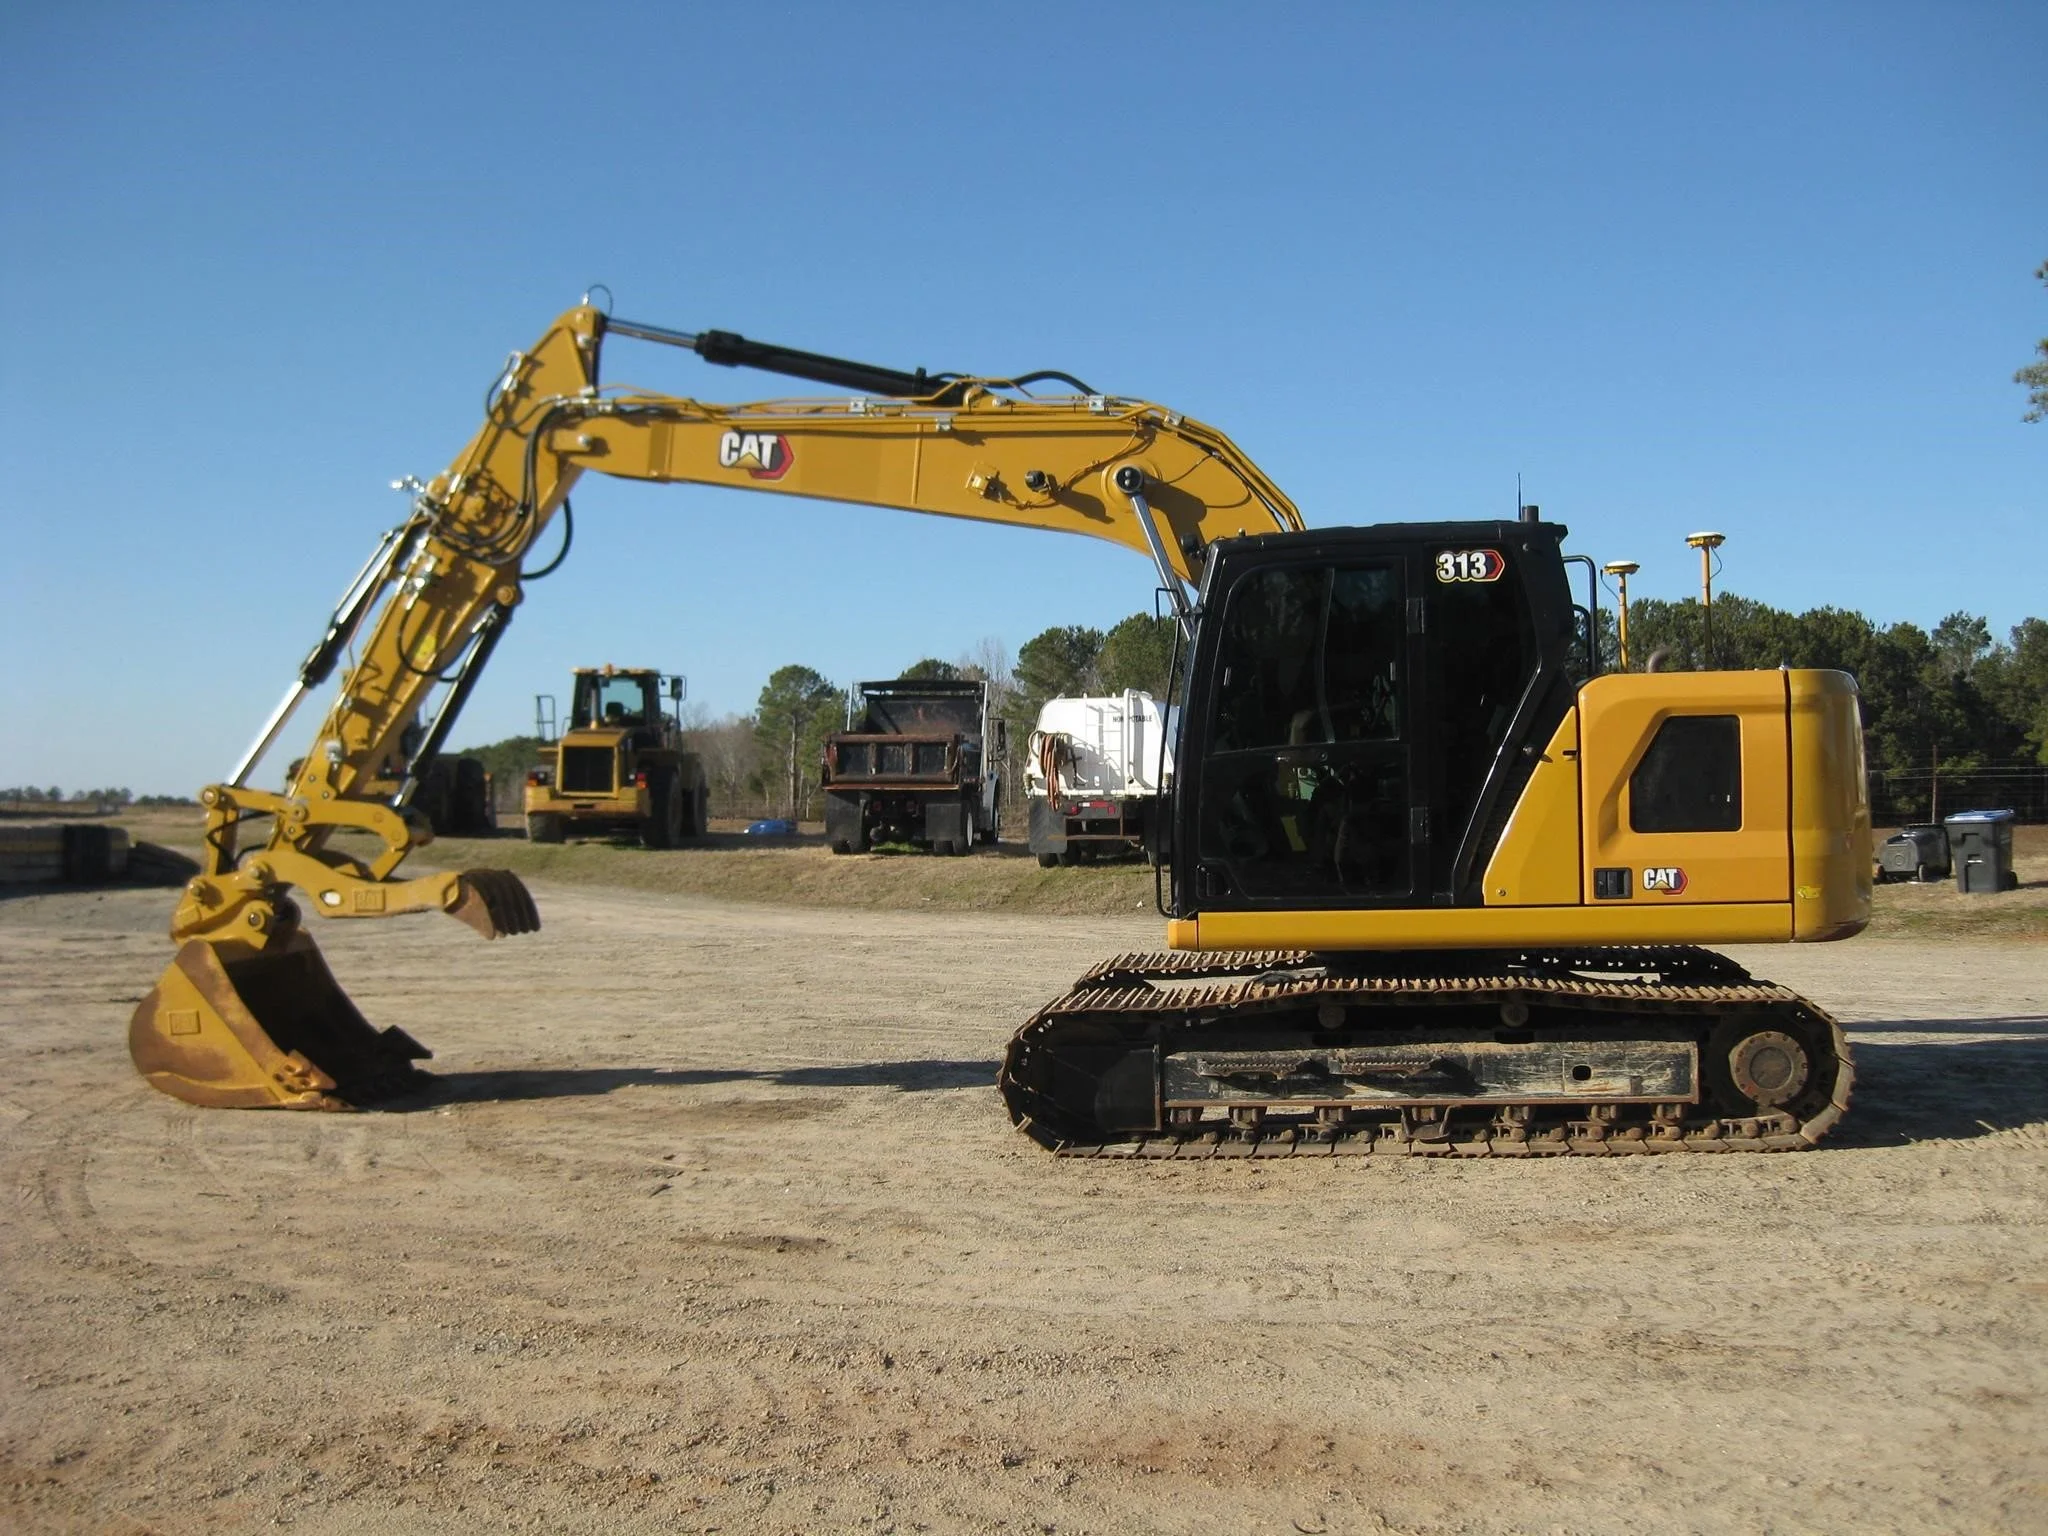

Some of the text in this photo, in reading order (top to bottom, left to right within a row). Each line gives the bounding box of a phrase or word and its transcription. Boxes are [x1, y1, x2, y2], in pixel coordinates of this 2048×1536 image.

[720, 431, 778, 470] CAT
[1439, 552, 1487, 579] 313
[1643, 868, 1677, 889] CAT
